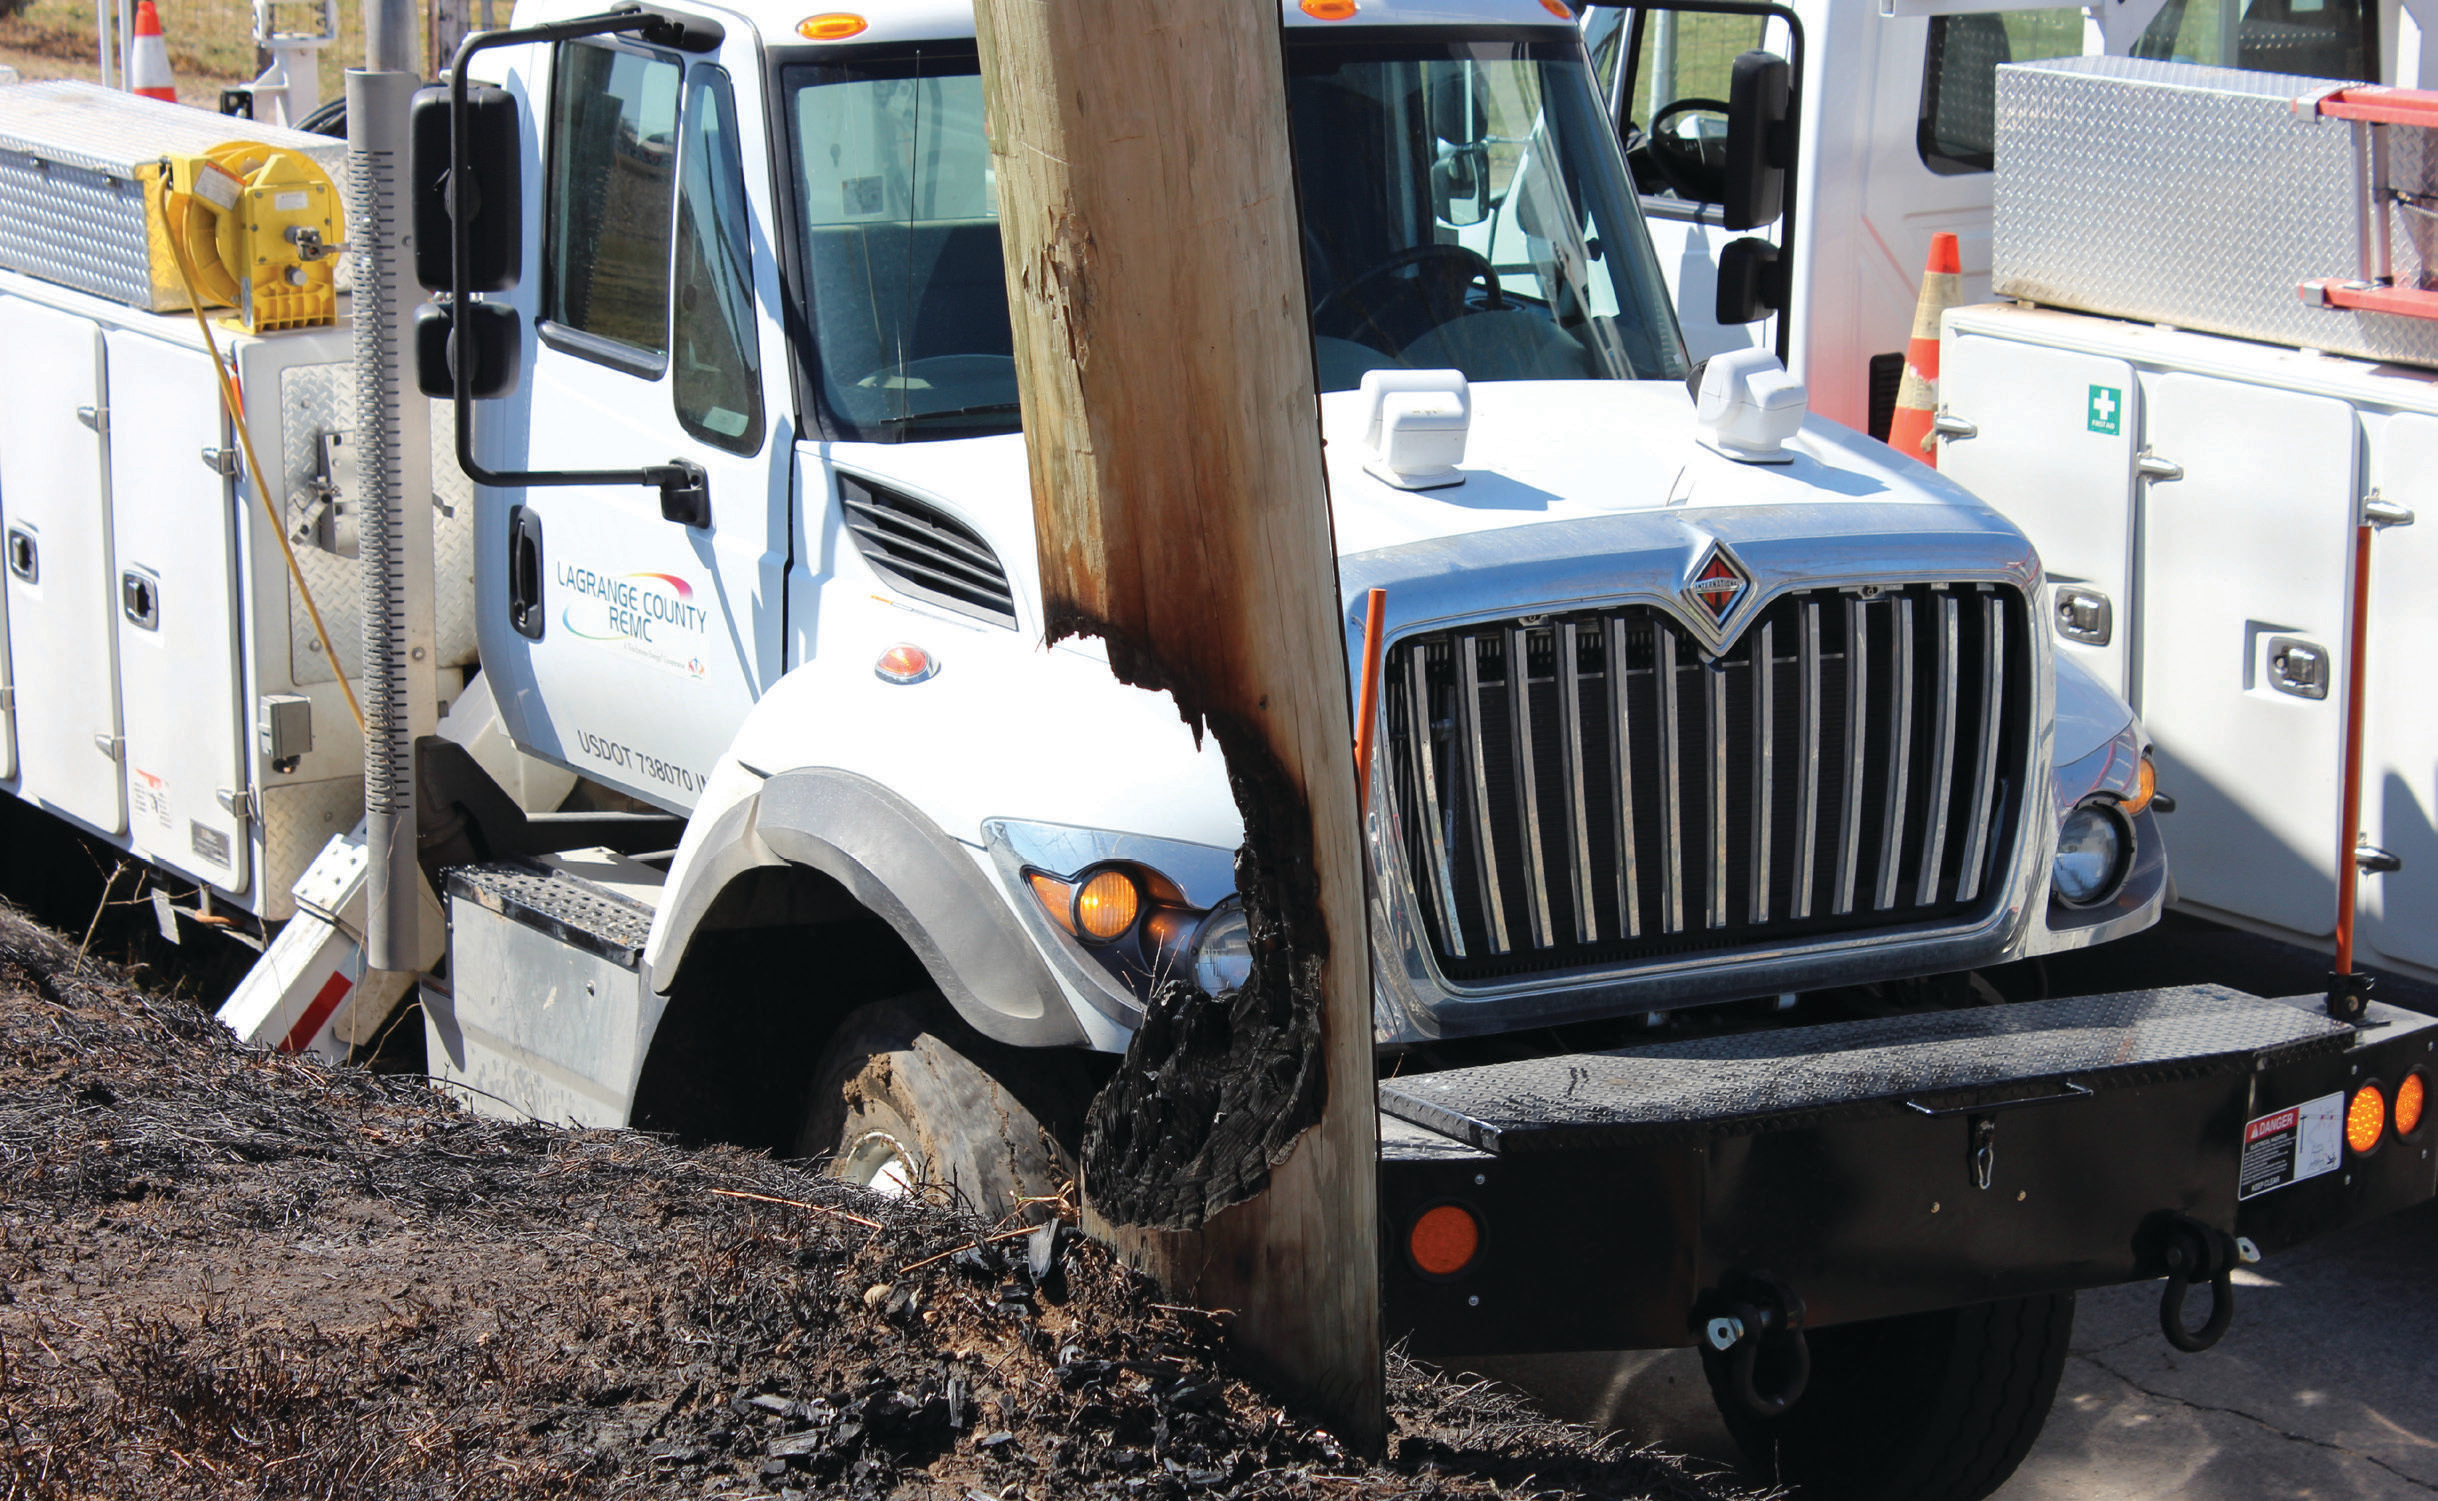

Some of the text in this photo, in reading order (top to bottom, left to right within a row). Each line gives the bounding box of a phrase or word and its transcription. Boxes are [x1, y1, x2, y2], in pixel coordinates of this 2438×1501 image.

[2091, 419, 2105, 428] FIRST
[557, 560, 707, 634] LAGRANGE COUNTY
[1695, 579, 1738, 588] INTERNATIONA
[609, 605, 653, 643] REMC
[577, 729, 633, 769] USDOT
[635, 751, 694, 792] 738070
[2259, 1112, 2294, 1136] DANGER
